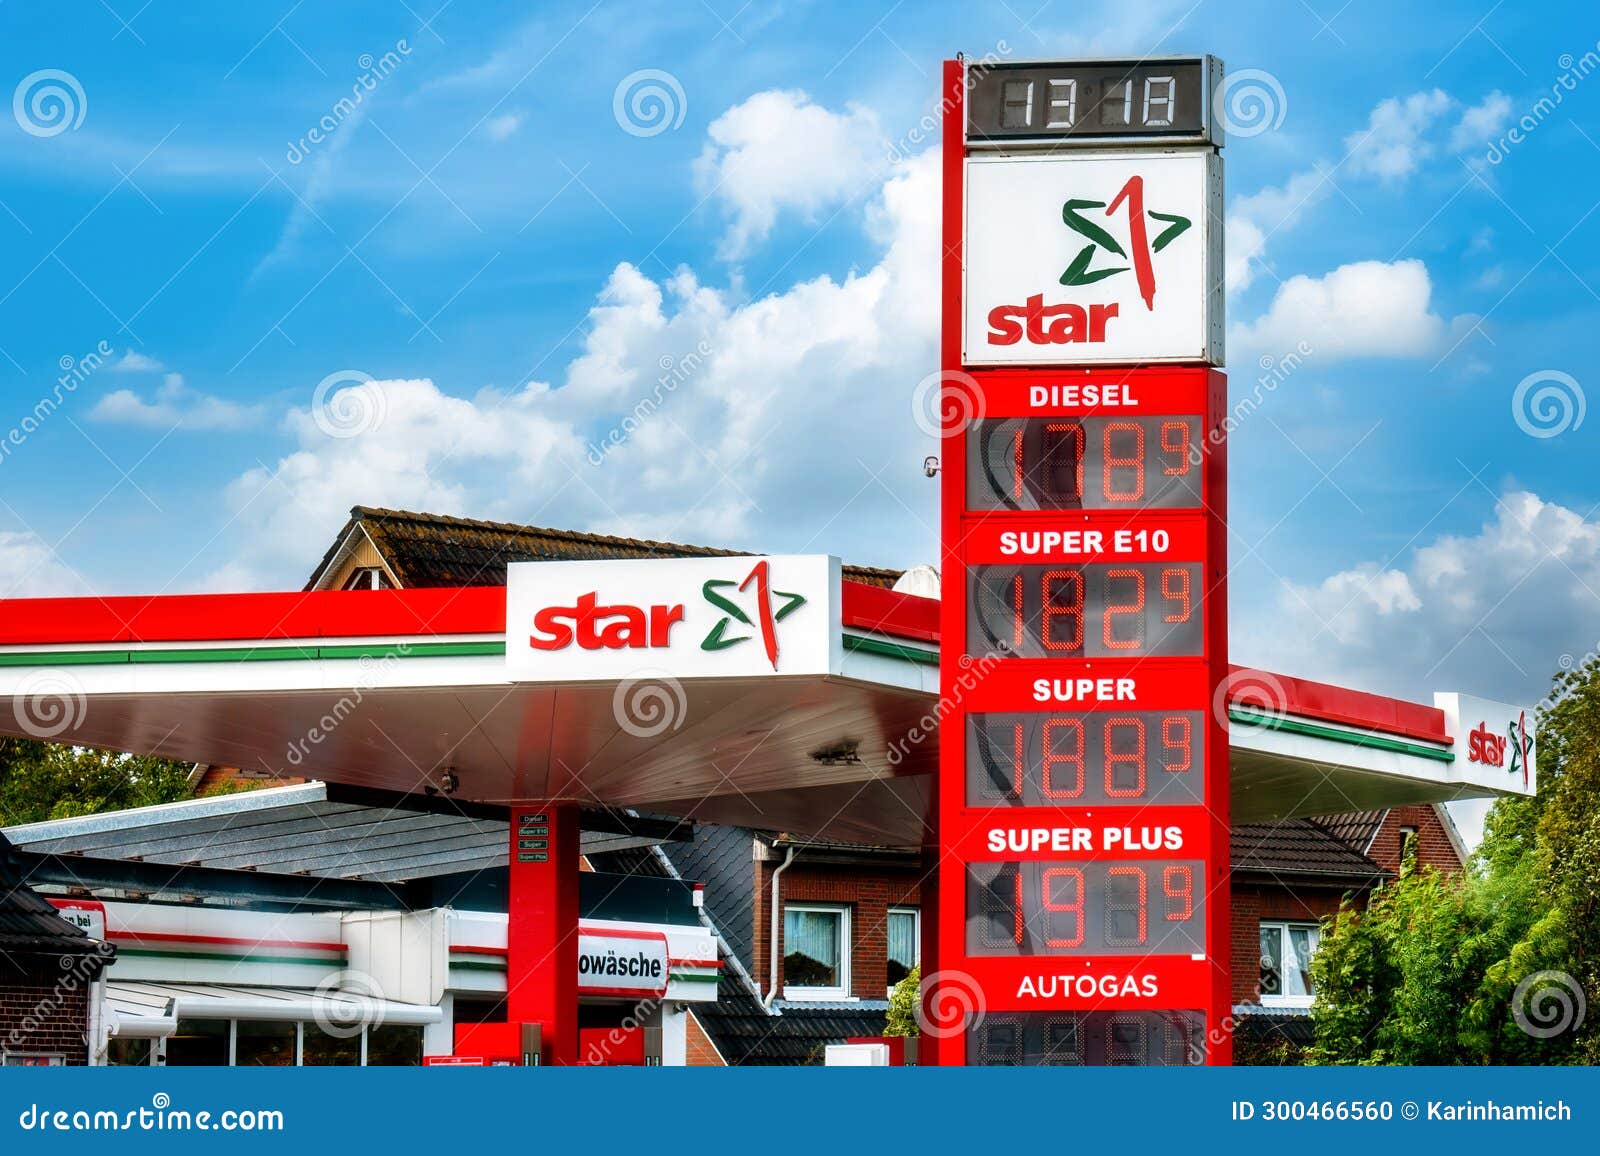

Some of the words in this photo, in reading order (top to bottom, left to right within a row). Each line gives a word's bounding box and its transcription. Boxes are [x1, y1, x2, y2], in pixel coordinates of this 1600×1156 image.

[987, 293, 1119, 346] star
[1029, 384, 1139, 407] DIESEL
[999, 531, 1104, 555] SUPER
[1113, 529, 1170, 554] E10
[529, 591, 684, 651] star
[1032, 678, 1137, 702] SUPER
[1468, 720, 1507, 768] star
[987, 828, 1093, 853] SUPER
[1103, 826, 1184, 851] PLUS
[77, 915, 91, 927] bei
[1016, 975, 1159, 998] AUTOGAS
